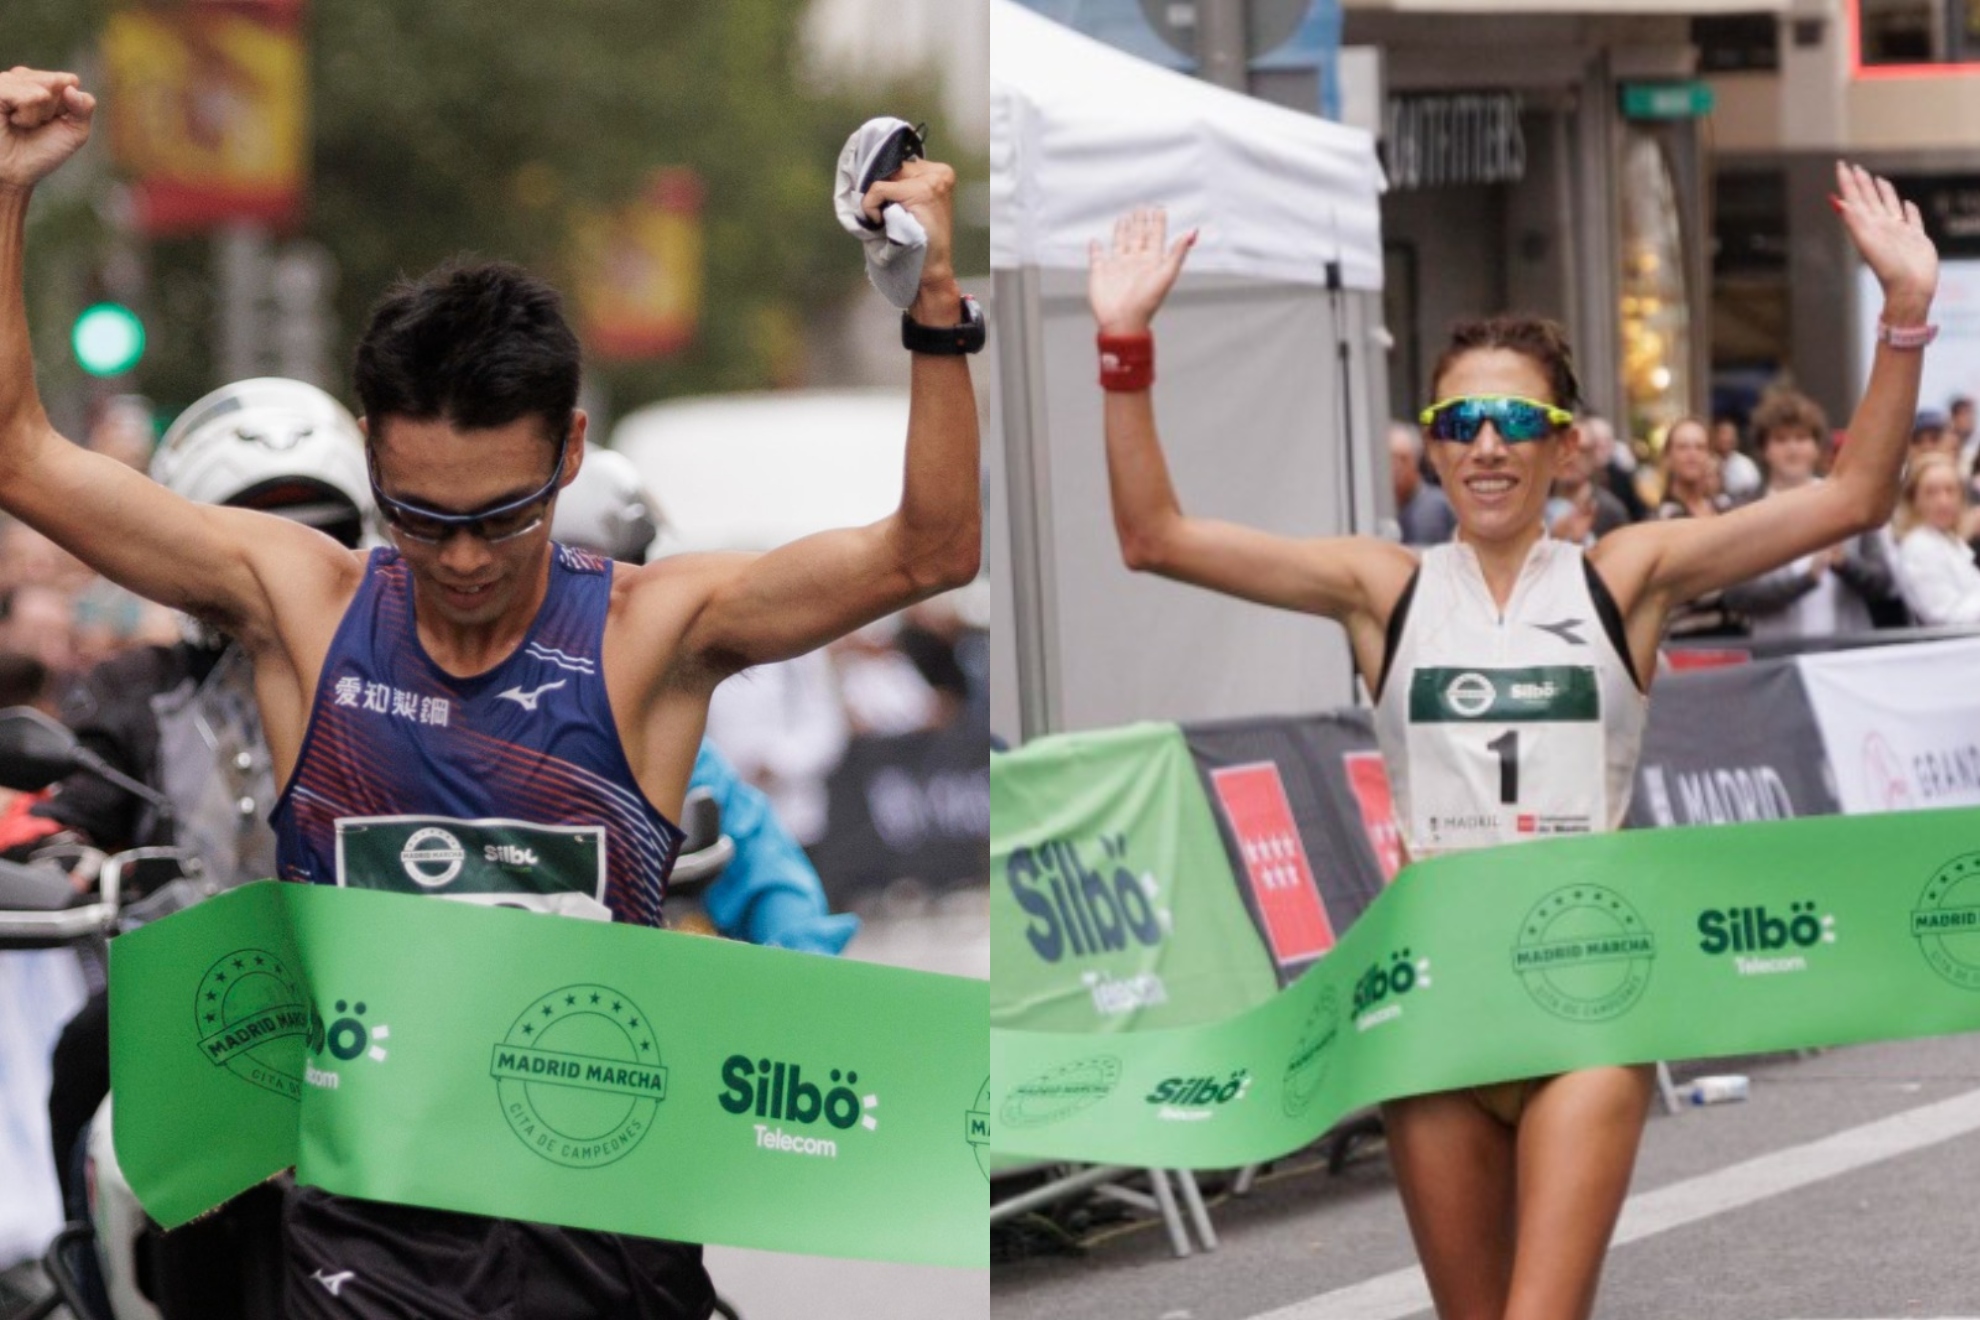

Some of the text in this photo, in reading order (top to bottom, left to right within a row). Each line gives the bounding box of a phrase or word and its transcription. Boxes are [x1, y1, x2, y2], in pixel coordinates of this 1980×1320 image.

[334, 677, 450, 727] 愛知製鋼
[1487, 730, 1518, 805] 1
[1007, 832, 1161, 964] Silbö
[1516, 937, 1651, 965] MADRID MARCHA
[1698, 901, 1821, 955] Silbö
[207, 1015, 277, 1058] MADRID
[498, 1052, 662, 1091] MADRID MARCHA
[718, 1055, 861, 1130] Silbö
[1145, 1068, 1248, 1105] Silbö
[509, 1102, 642, 1160] CITA DE CAMPEONES
[754, 1124, 837, 1157] Telecom
